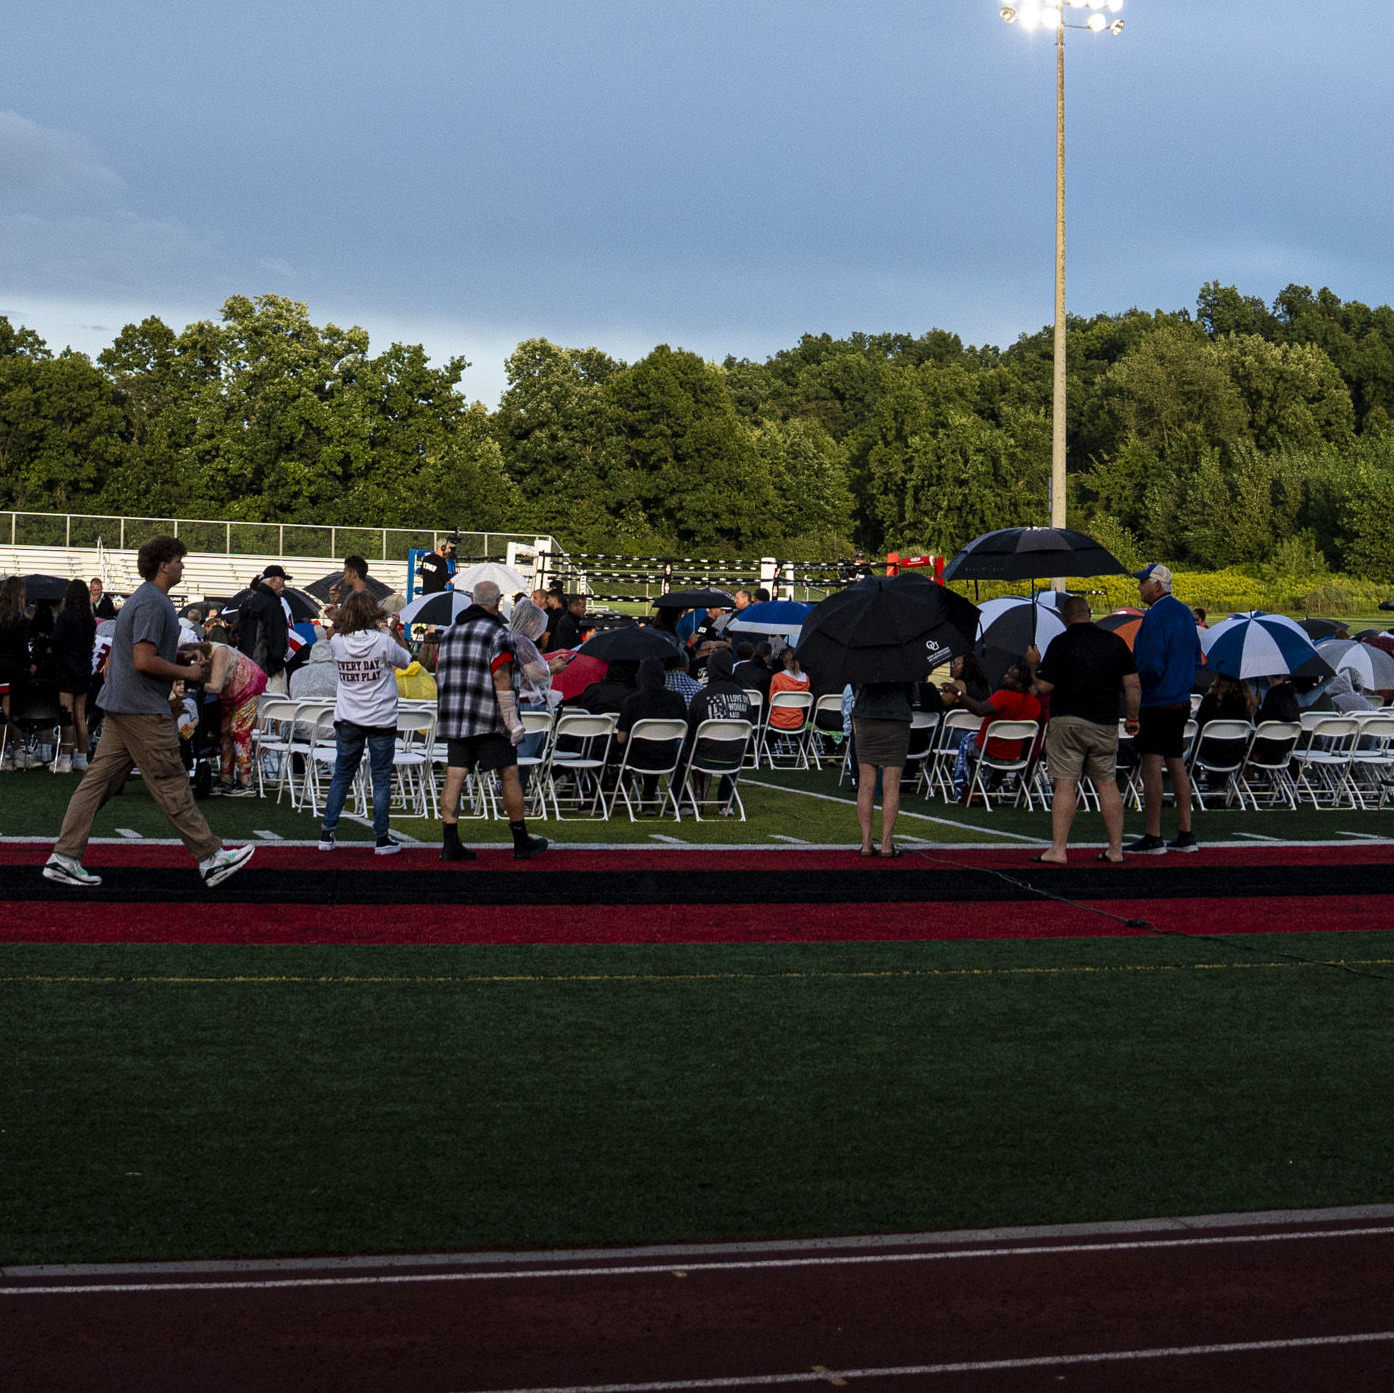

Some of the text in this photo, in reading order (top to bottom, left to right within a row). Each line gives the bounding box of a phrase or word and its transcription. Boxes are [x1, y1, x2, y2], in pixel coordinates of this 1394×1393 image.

[337, 660, 380, 671] EVERY DAY
[339, 671, 381, 681] EVERY PLAY
